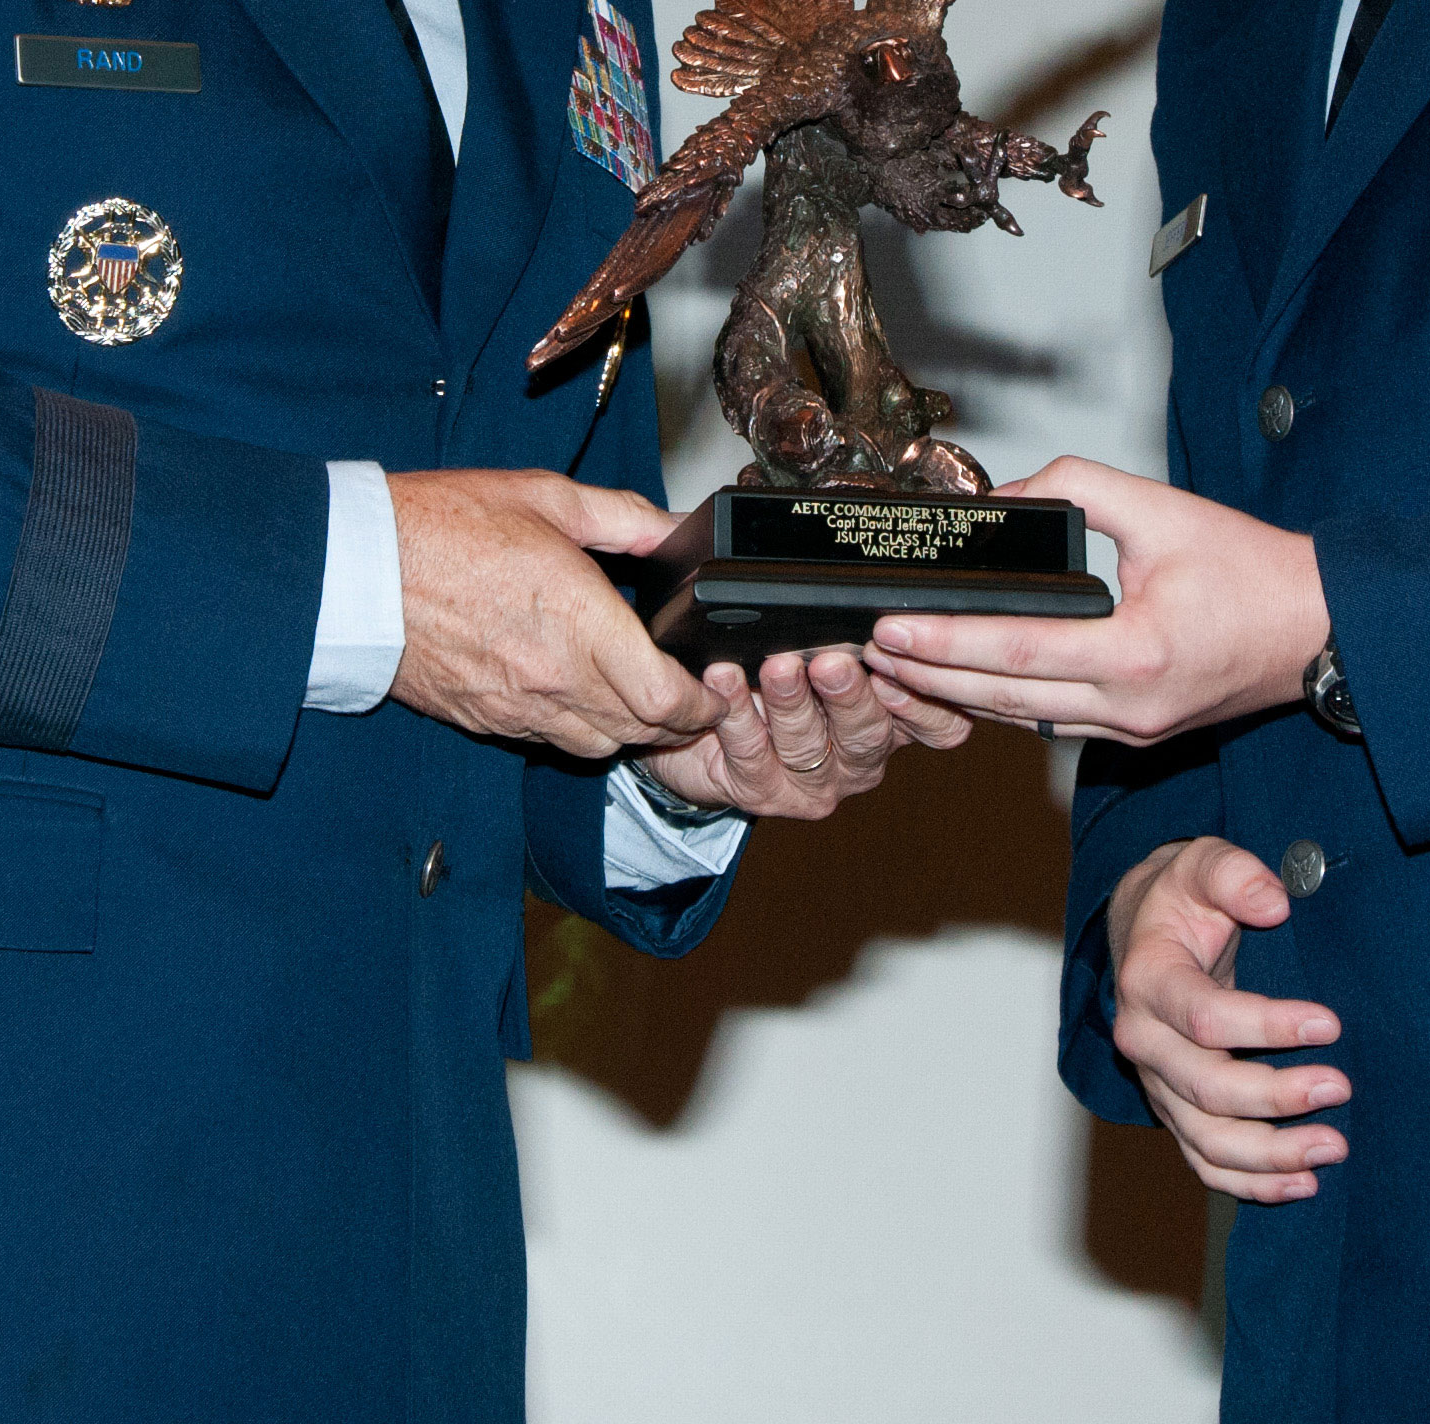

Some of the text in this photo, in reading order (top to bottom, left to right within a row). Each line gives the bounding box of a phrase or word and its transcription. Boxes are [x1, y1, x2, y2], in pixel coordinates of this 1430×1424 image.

[76, 47, 143, 73] RAND
[791, 502, 1007, 524] AETC COMMANDER'S TROPHY
[826, 515, 971, 537] Capt David Jeffery (T-38)
[834, 531, 964, 548] JSUPT CLASS 14-14
[861, 544, 938, 560] VANCE AFB
